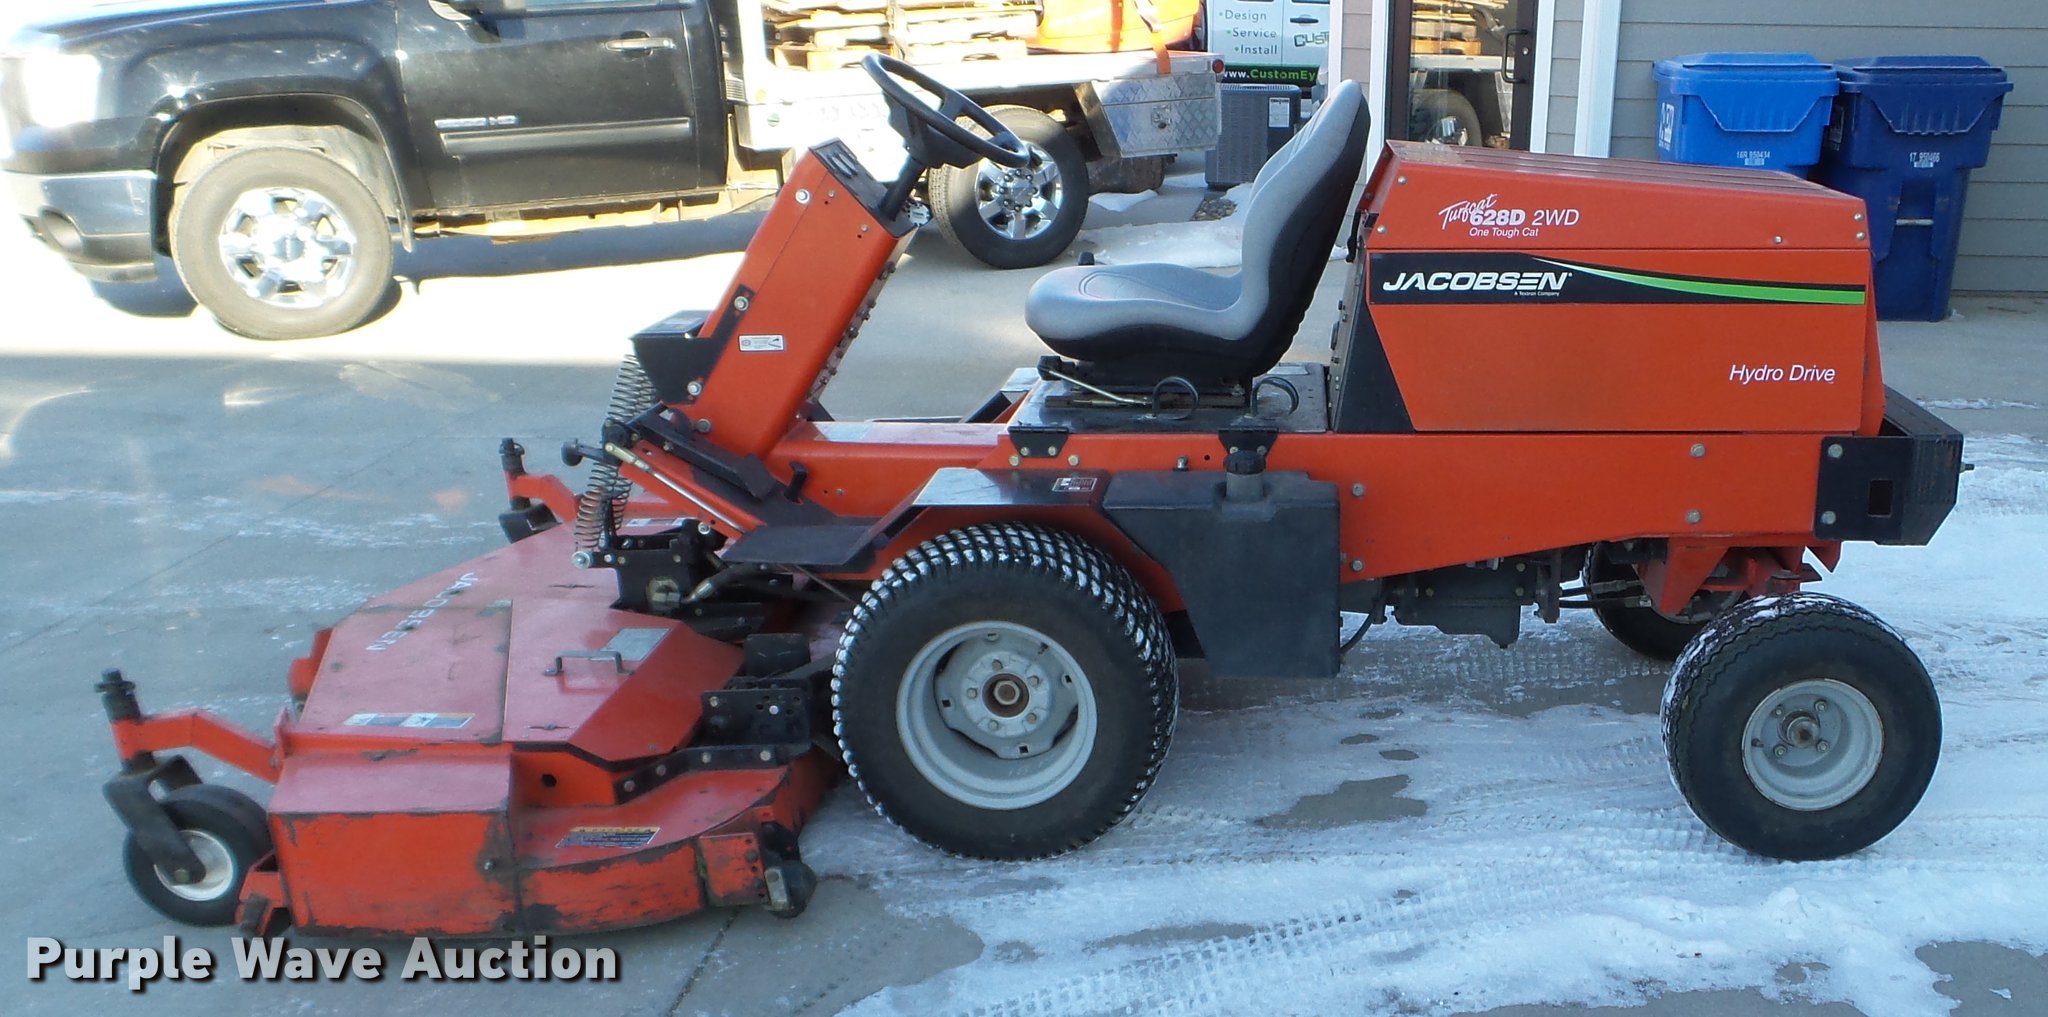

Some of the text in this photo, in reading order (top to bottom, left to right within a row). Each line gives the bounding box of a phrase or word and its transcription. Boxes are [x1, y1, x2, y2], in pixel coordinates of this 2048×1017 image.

[1225, 9, 1267, 22] Design
[1232, 27, 1277, 38] Service
[1240, 44, 1278, 54] Install
[1438, 193, 1498, 230] Turfcat
[1469, 209, 1580, 226] 628D 2WD
[1469, 227, 1539, 239] One Tough Cat
[1382, 272, 1568, 291] JACOBSEN
[1729, 364, 1836, 385] Hydro Drive
